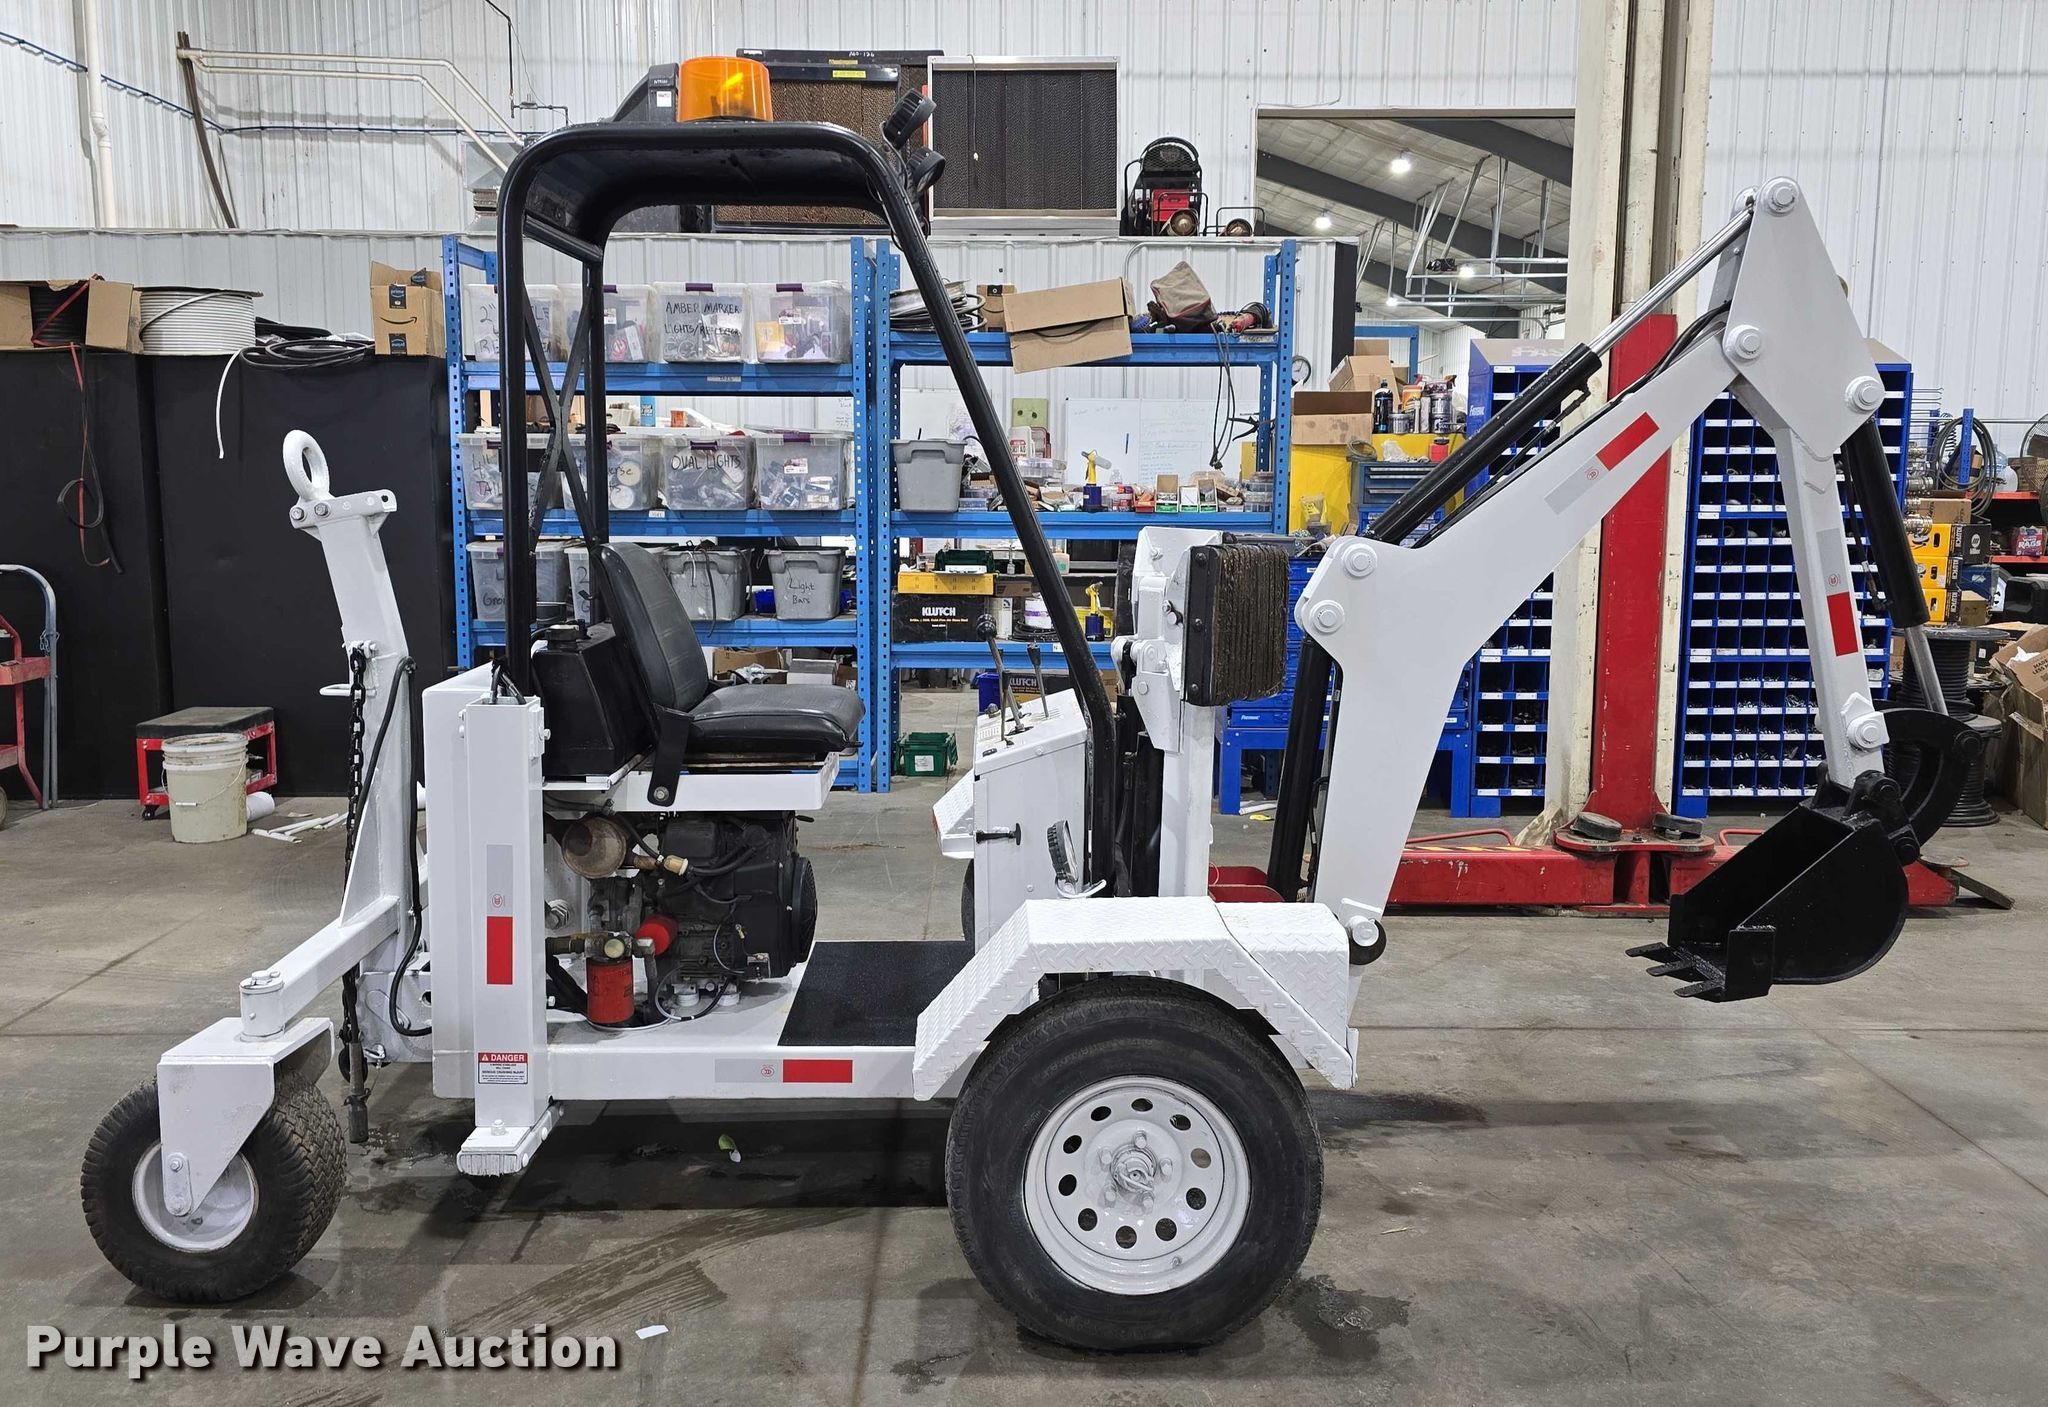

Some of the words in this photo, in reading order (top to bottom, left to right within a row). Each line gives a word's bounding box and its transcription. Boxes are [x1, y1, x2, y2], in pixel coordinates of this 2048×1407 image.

[704, 302, 740, 314] MARKER
[671, 455, 702, 470] OVAL
[706, 456, 741, 470] LIGHTS
[922, 607, 956, 617] KLUTCH
[490, 1054, 525, 1062] DANGER
